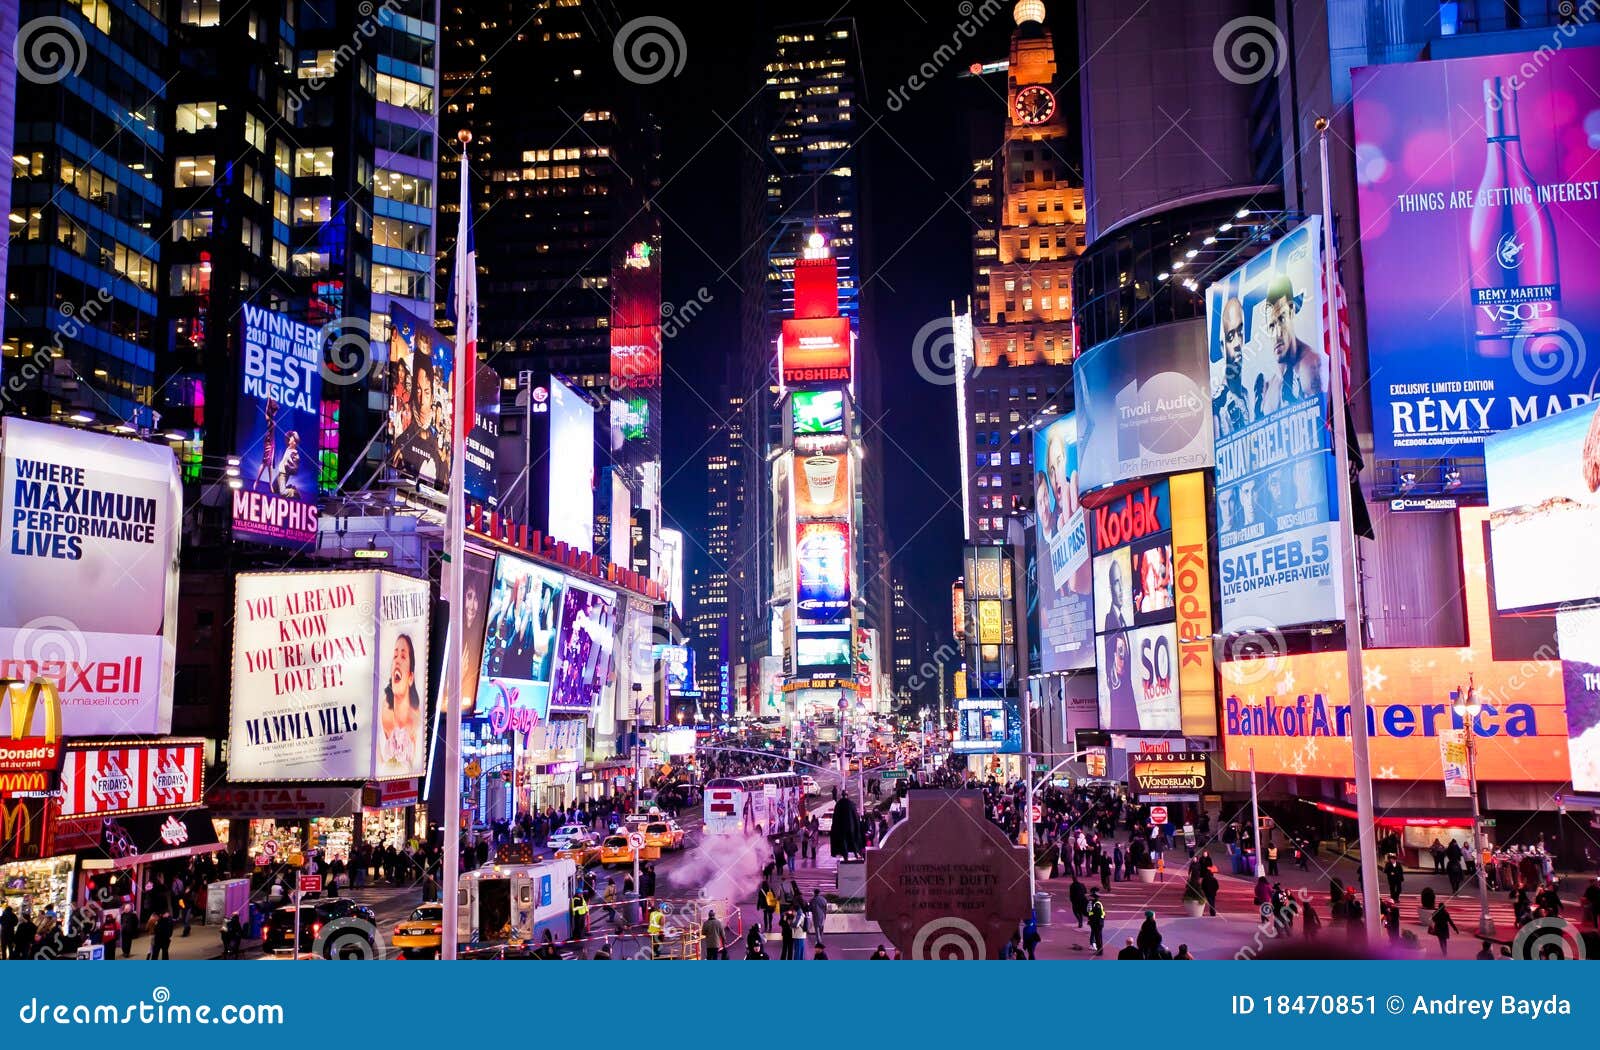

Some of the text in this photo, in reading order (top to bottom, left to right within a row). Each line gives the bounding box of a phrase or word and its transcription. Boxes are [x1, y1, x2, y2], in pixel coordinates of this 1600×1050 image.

[1398, 181, 1599, 213] THINGS ARE GETTING INTEREST
[795, 258, 836, 267] TOSHIBA
[1510, 286, 1552, 299] MARTIN
[243, 303, 321, 349] WINNER!
[1480, 302, 1552, 322] VSOP
[246, 326, 268, 346] 2010
[269, 333, 291, 354] TONY
[245, 342, 317, 394] BEST
[784, 368, 849, 381] TOSHIBA
[244, 375, 316, 415] MUSICAL
[1390, 380, 1494, 395] EXCLUSIVE LIMITED EDITION
[533, 402, 547, 412] LG
[1120, 395, 1196, 419] Tivoli Audio
[1390, 397, 1495, 433] RÉMY
[475, 412, 499, 437] HAEL
[1394, 435, 1487, 447] FACEBOOK.COM/REMYMARTI
[16, 458, 85, 486] WHERE
[1141, 453, 1207, 469] Anniversary
[14, 479, 157, 524] MAXIMUM
[233, 489, 318, 532] MEMPHIS
[13, 508, 155, 543] PERFORMANCE
[1096, 486, 1161, 551] Kodak
[11, 529, 82, 561] LIVES
[1052, 522, 1086, 574] HALL PASS
[1222, 552, 1259, 583] SAT.
[1223, 563, 1330, 596] LIVE ON PAY-PER-VIEW
[246, 584, 358, 621] YOU ALREADY
[1177, 544, 1208, 667] Kodak
[279, 613, 330, 642] KNOW
[982, 628, 999, 639] KING
[245, 634, 367, 672] YOU'RE GONNA
[1142, 636, 1171, 686] SO
[1, 656, 143, 693] maxell
[274, 663, 344, 695] LOVE IT!
[1143, 677, 1172, 700] Kodak
[40, 697, 139, 706] ww.maxell.com
[246, 703, 358, 746] MAMMA MIA!
[1134, 753, 1206, 761] MARQUIS
[1137, 775, 1205, 789] WONDERLAND
